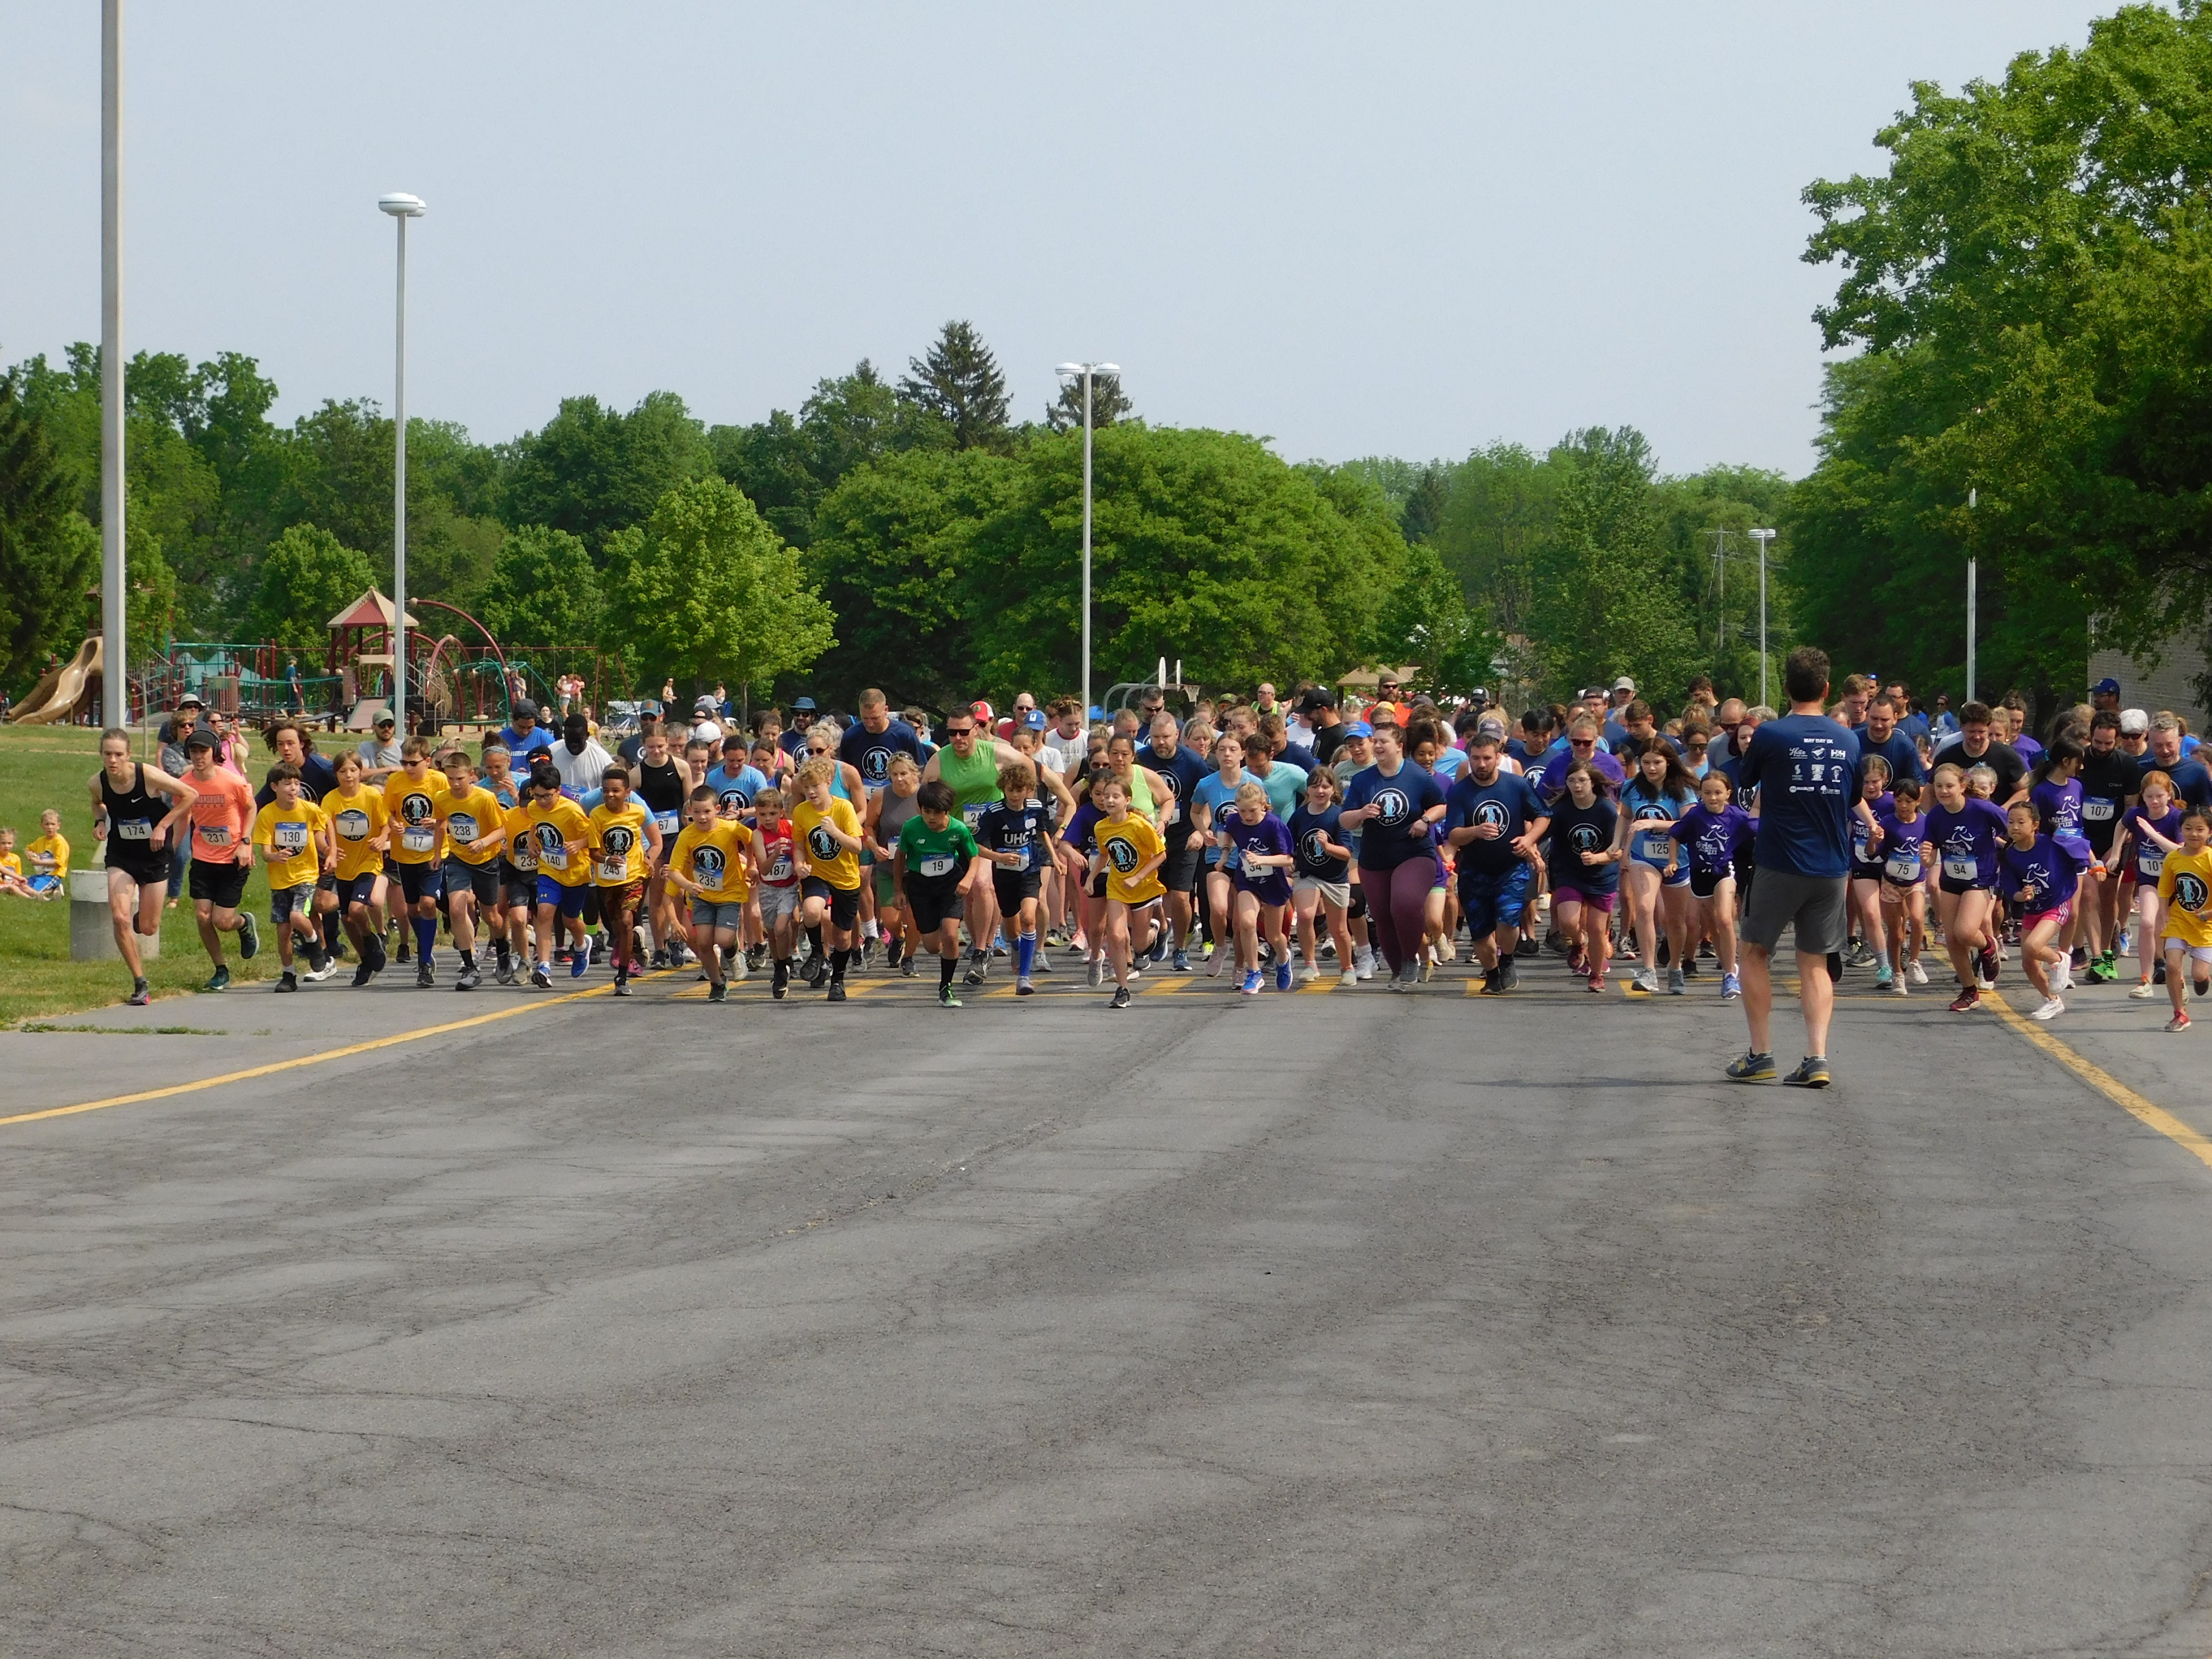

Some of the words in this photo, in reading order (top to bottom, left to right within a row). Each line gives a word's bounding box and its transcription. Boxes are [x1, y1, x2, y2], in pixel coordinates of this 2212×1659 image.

[866, 767, 875, 777] MAY
[1741, 800, 1751, 810] MAY
[2090, 806, 2108, 816] 107
[349, 822, 354, 832] 7
[658, 820, 669, 830] 67
[1500, 823, 1507, 832] 5K
[126, 827, 145, 836] 174
[454, 826, 471, 835] 238
[207, 833, 224, 842] 231
[283, 832, 300, 842] 130
[413, 837, 424, 847] 17
[1004, 831, 1030, 844] UHC
[812, 847, 821, 857] MAY
[1651, 843, 1669, 854] 125
[521, 856, 538, 867] 233
[546, 855, 561, 866] 140
[932, 861, 943, 871] 19
[1897, 864, 1909, 875] 75
[1954, 865, 1966, 874] 94
[2147, 861, 2163, 871] 101
[699, 874, 716, 887] 235
